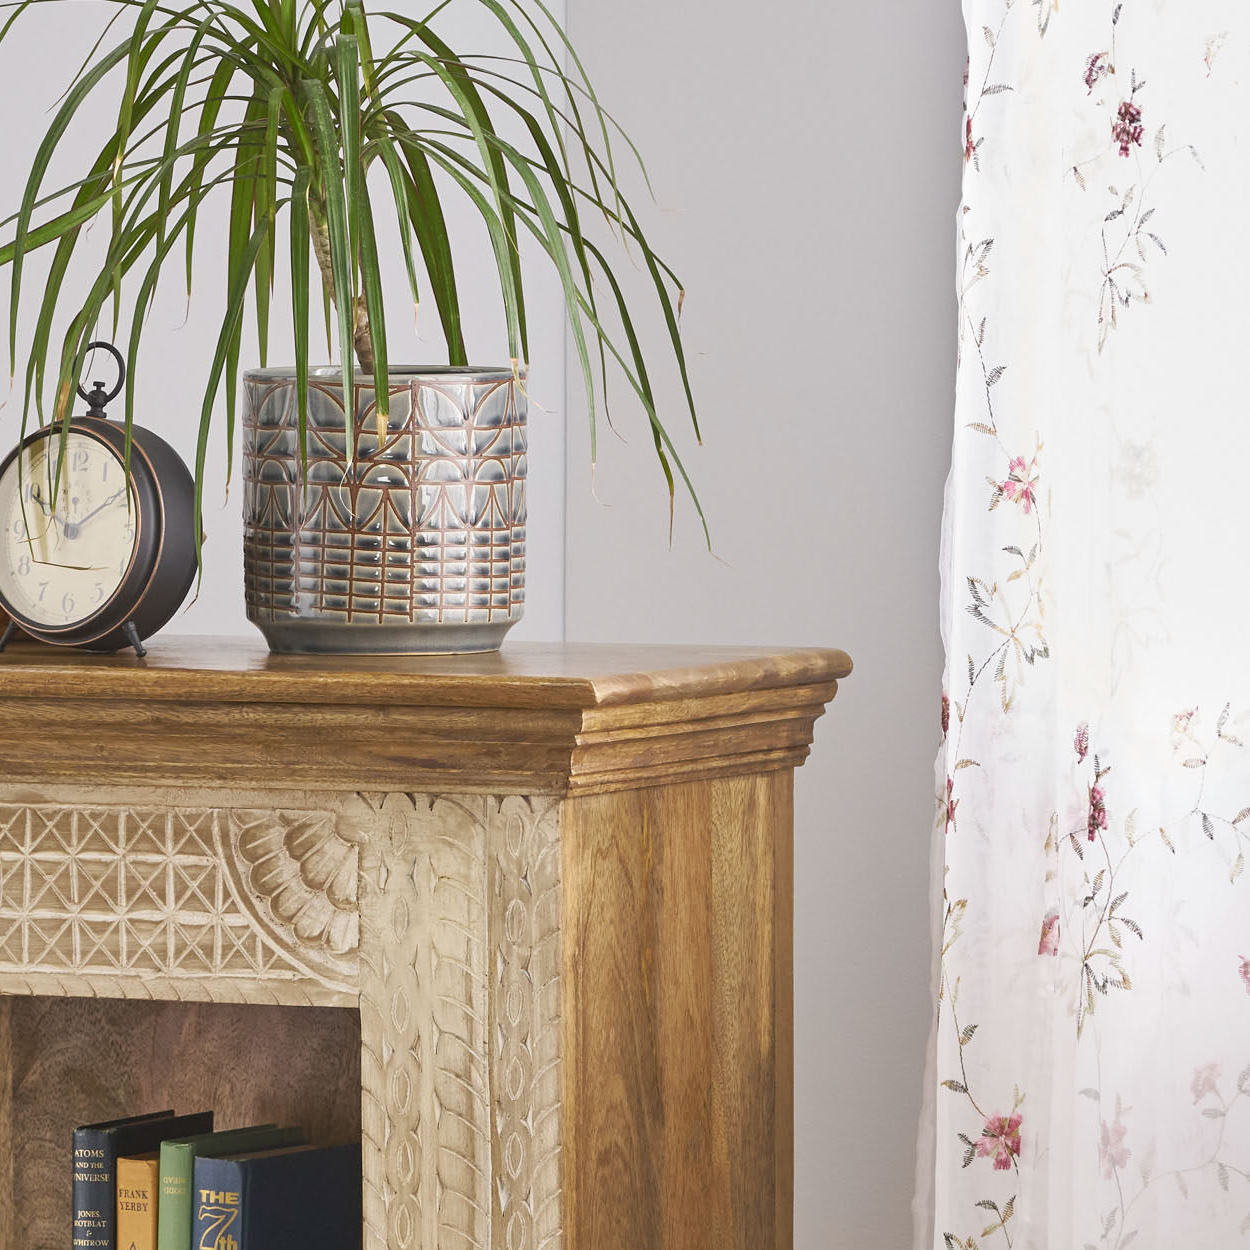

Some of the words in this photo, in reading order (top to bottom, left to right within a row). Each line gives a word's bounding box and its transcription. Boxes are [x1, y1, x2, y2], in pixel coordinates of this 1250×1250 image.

[71, 451, 89, 473] 12
[18, 555, 31, 576] 8
[38, 581, 49, 602] 7
[61, 592, 75, 614] 6
[74, 1149, 104, 1158] ATOMS
[75, 1161, 89, 1169] AND
[118, 1188, 149, 1200] FRANK
[198, 1189, 239, 1205] THE
[119, 1201, 149, 1212] YERBY
[74, 1220, 107, 1228] ROTBLAT
[73, 1239, 110, 1247] WHITROW
